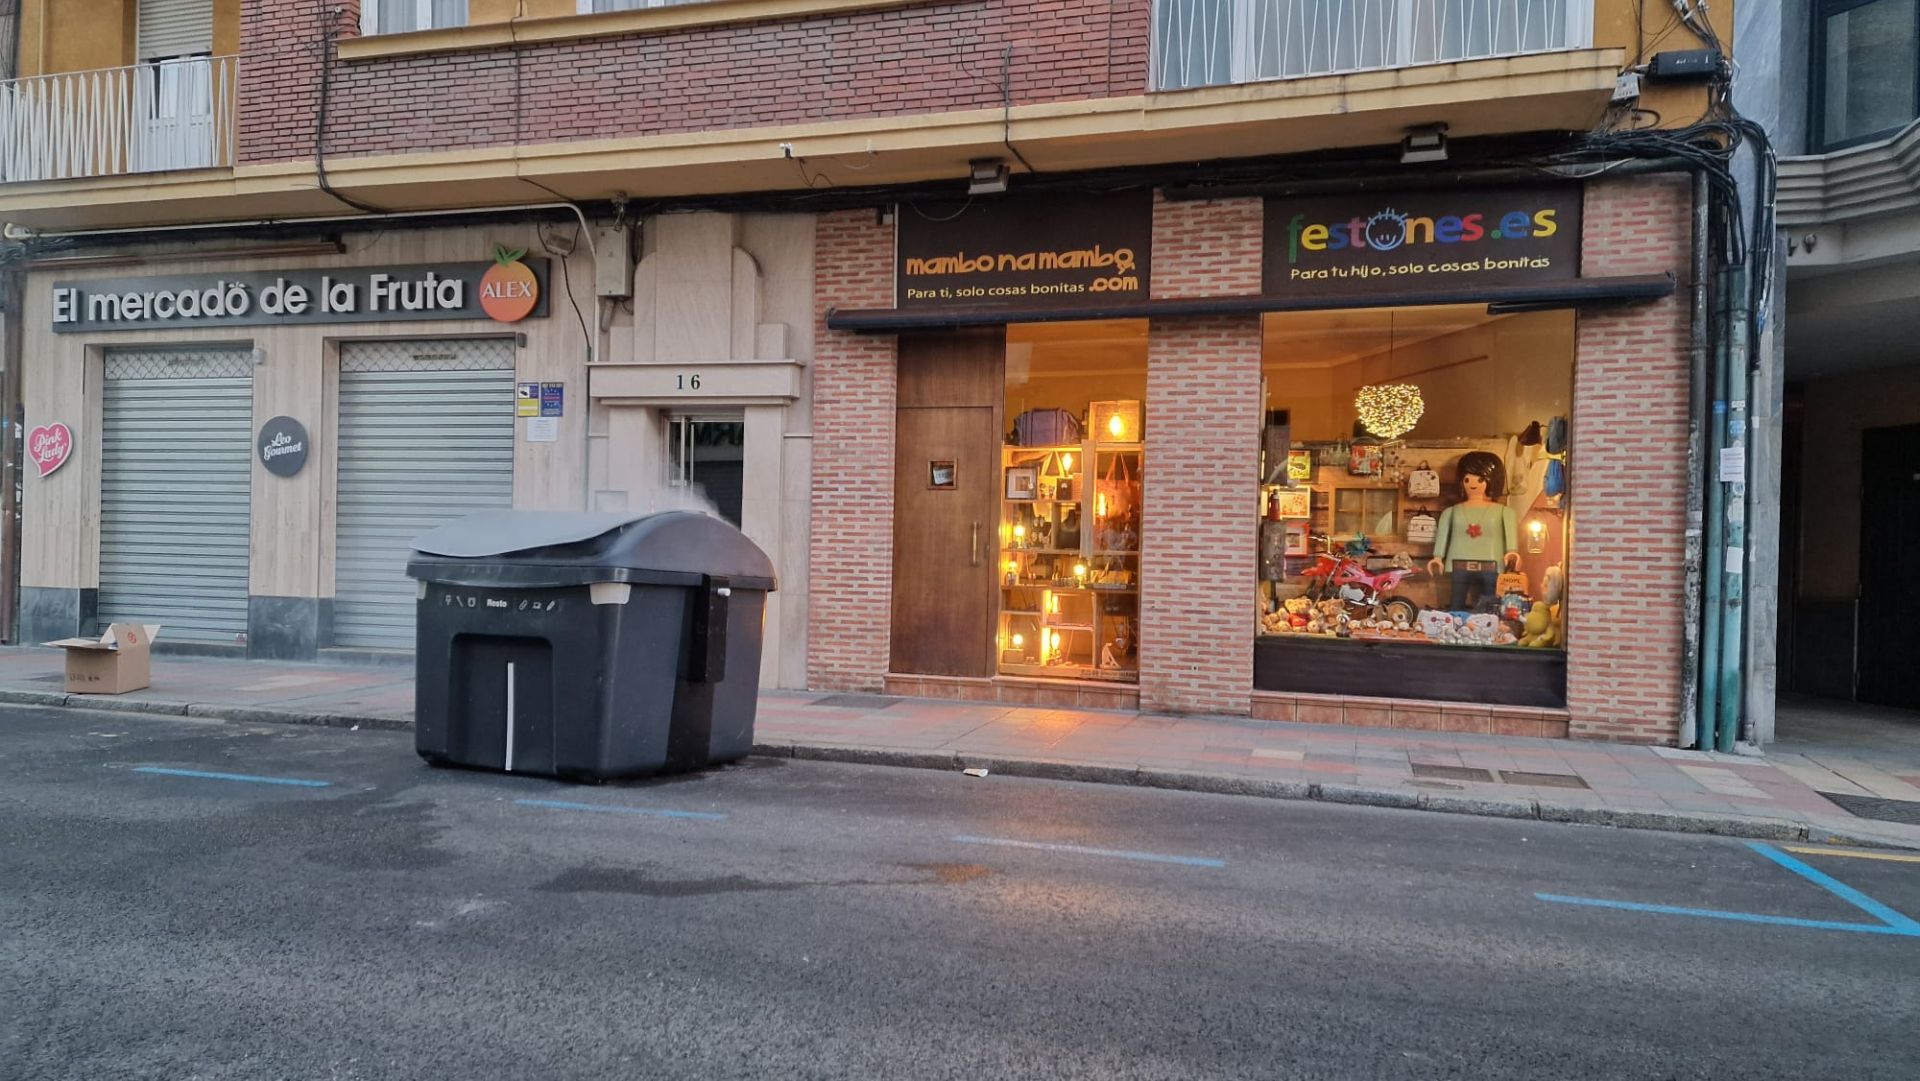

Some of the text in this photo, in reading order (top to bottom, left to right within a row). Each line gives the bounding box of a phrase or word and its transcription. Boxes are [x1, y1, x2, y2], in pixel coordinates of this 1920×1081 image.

[1291, 256, 1550, 280] Para tu hijo, solo cosas bonitas
[482, 281, 532, 298] ALEX
[907, 282, 1085, 299] Para ti, solo cosas bonitas
[1089, 276, 1139, 291] .com
[54, 272, 463, 322] El mercado de la Fruta
[676, 374, 701, 390] 16
[33, 428, 62, 452] Pink
[271, 432, 291, 447] Leo
[38, 443, 64, 463] Lady
[264, 442, 302, 461] Gourmet
